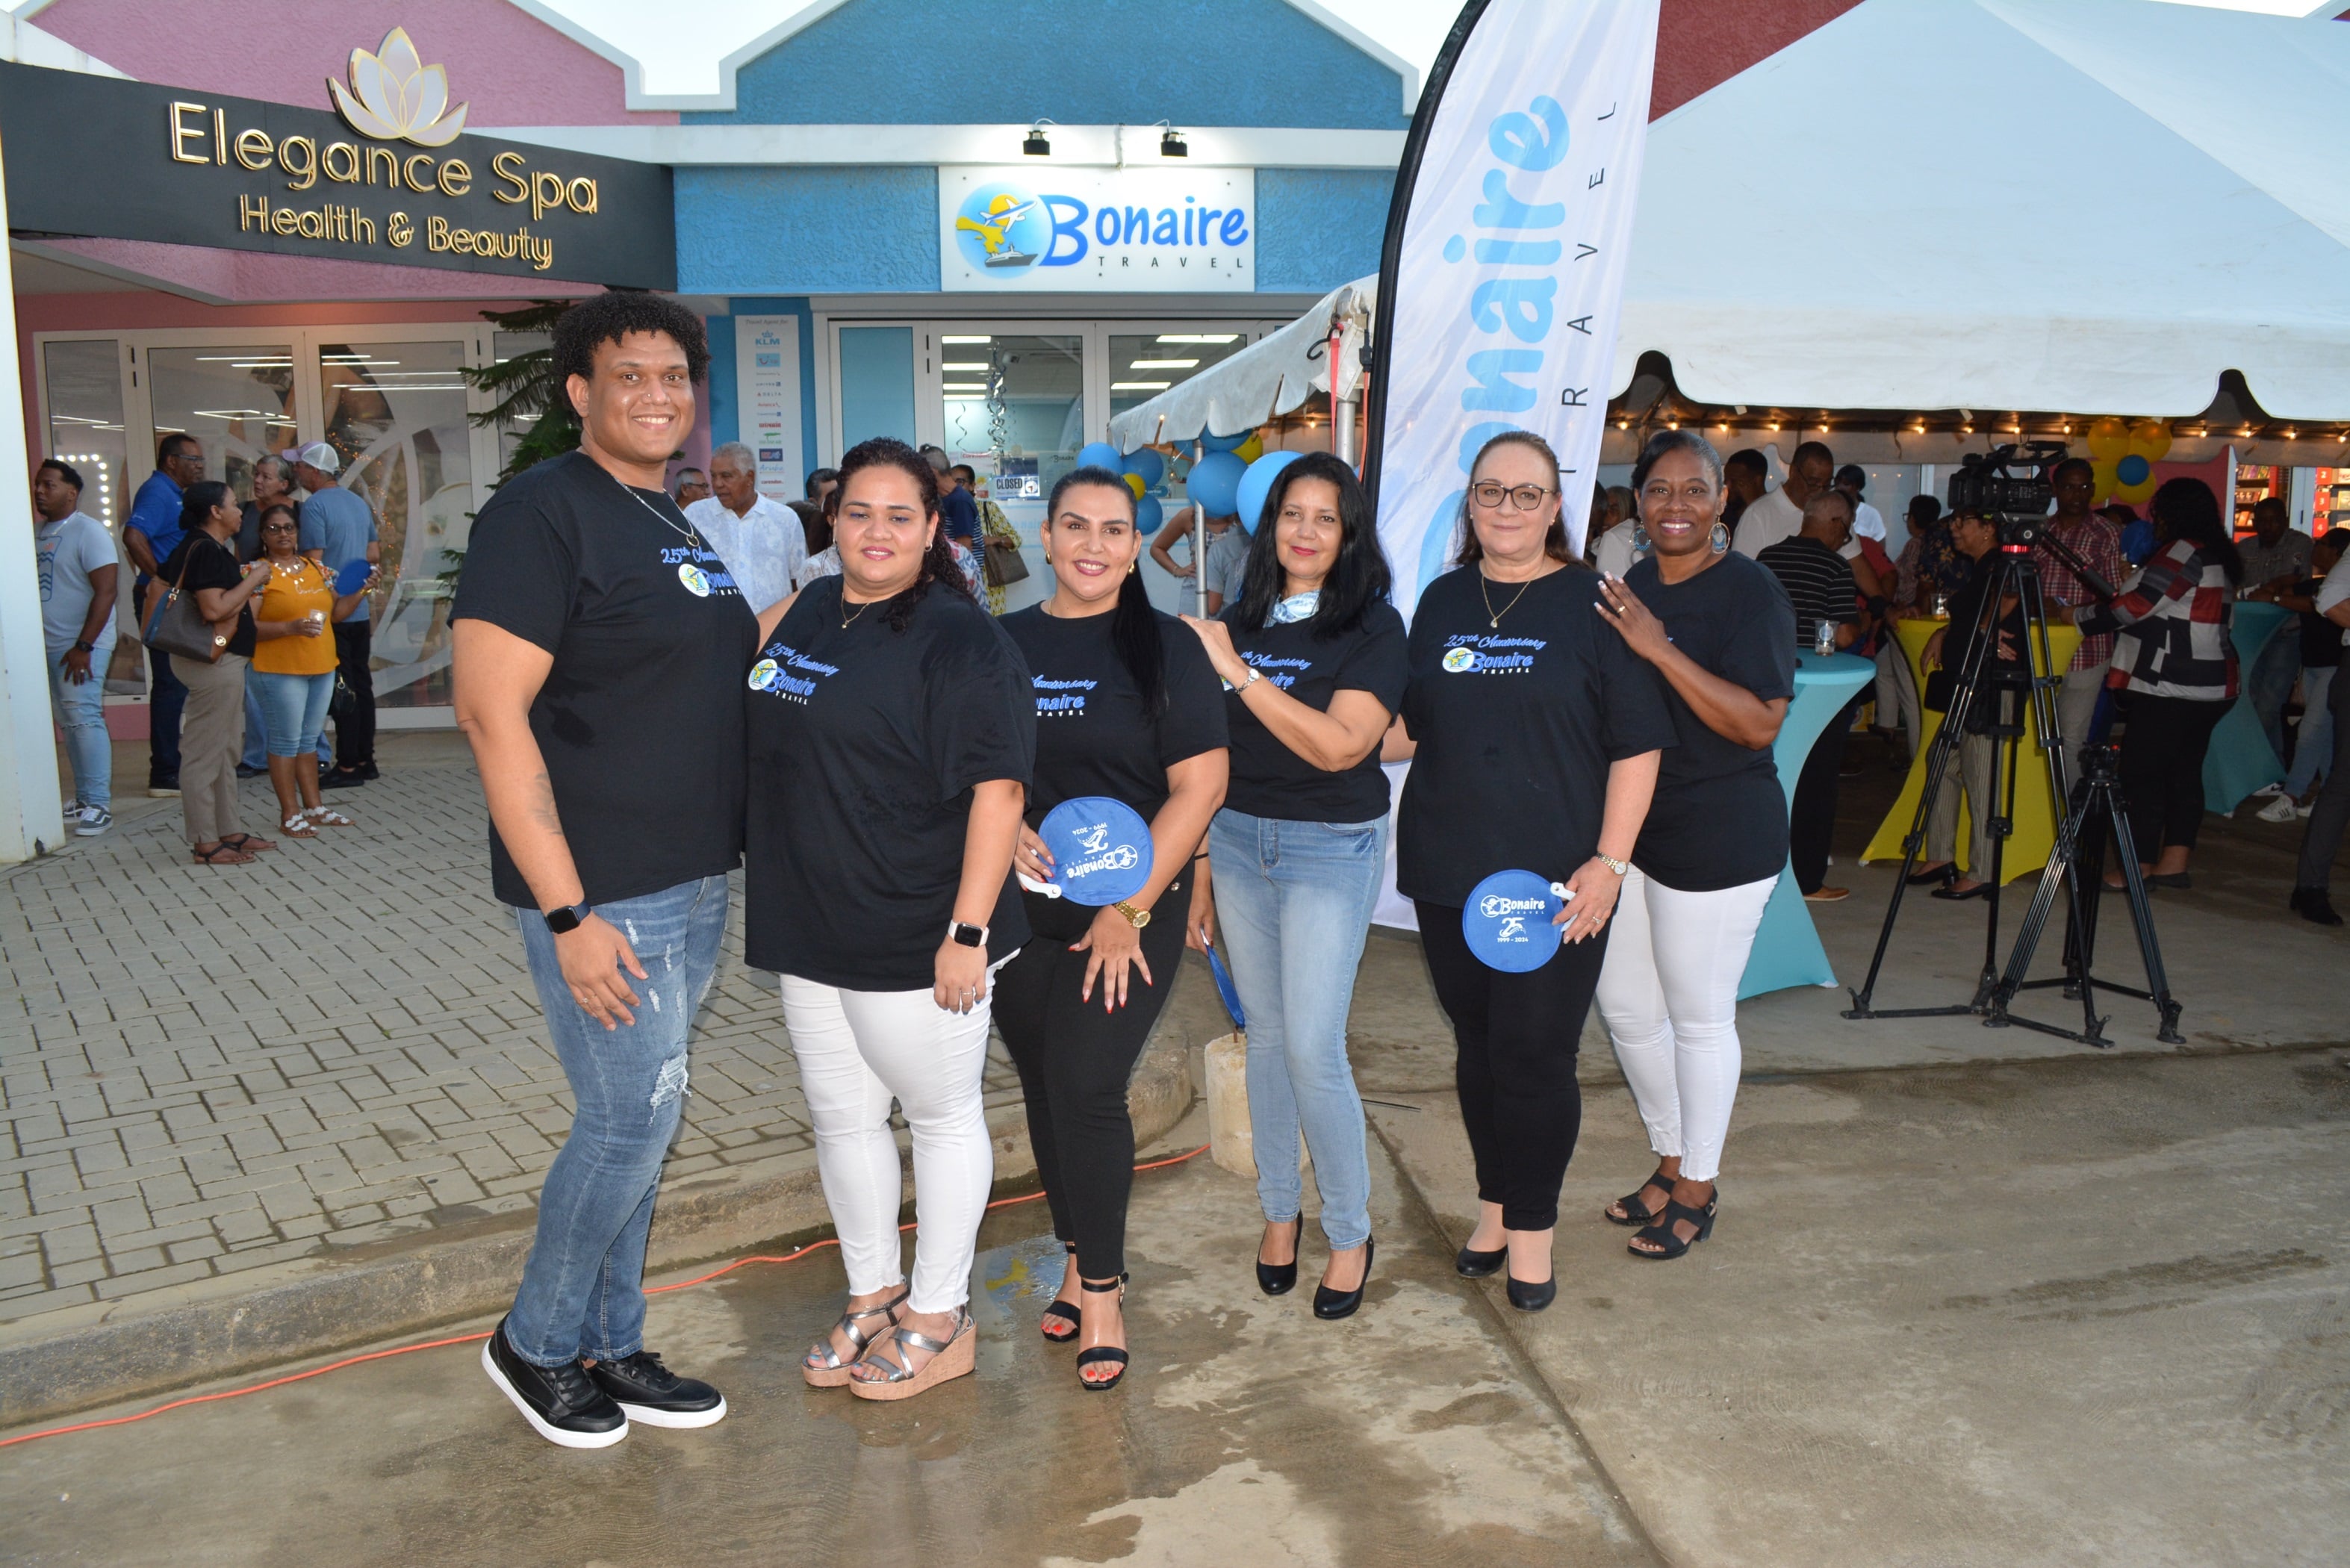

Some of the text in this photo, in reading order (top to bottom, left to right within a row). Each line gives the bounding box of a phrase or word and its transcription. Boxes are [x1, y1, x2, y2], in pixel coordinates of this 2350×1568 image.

[169, 101, 599, 220] Elegance Spa
[239, 193, 553, 271] Health & Beauty
[1038, 194, 1249, 267] Bonaire
[1098, 256, 1243, 268] TRAVEL
[1558, 101, 1617, 473] TRAVEL
[996, 478, 1023, 490] CLOSED
[764, 642, 797, 658] 25th
[1443, 634, 1479, 647] 25th
[1464, 651, 1534, 672] Bonaire
[762, 666, 817, 696] Bonaire
[775, 690, 808, 705] TRAVEL
[1036, 694, 1085, 710] naire
[1066, 851, 1119, 878] Bonaire
[1499, 897, 1546, 915] Bonaire
[1499, 917, 1526, 938] 25
